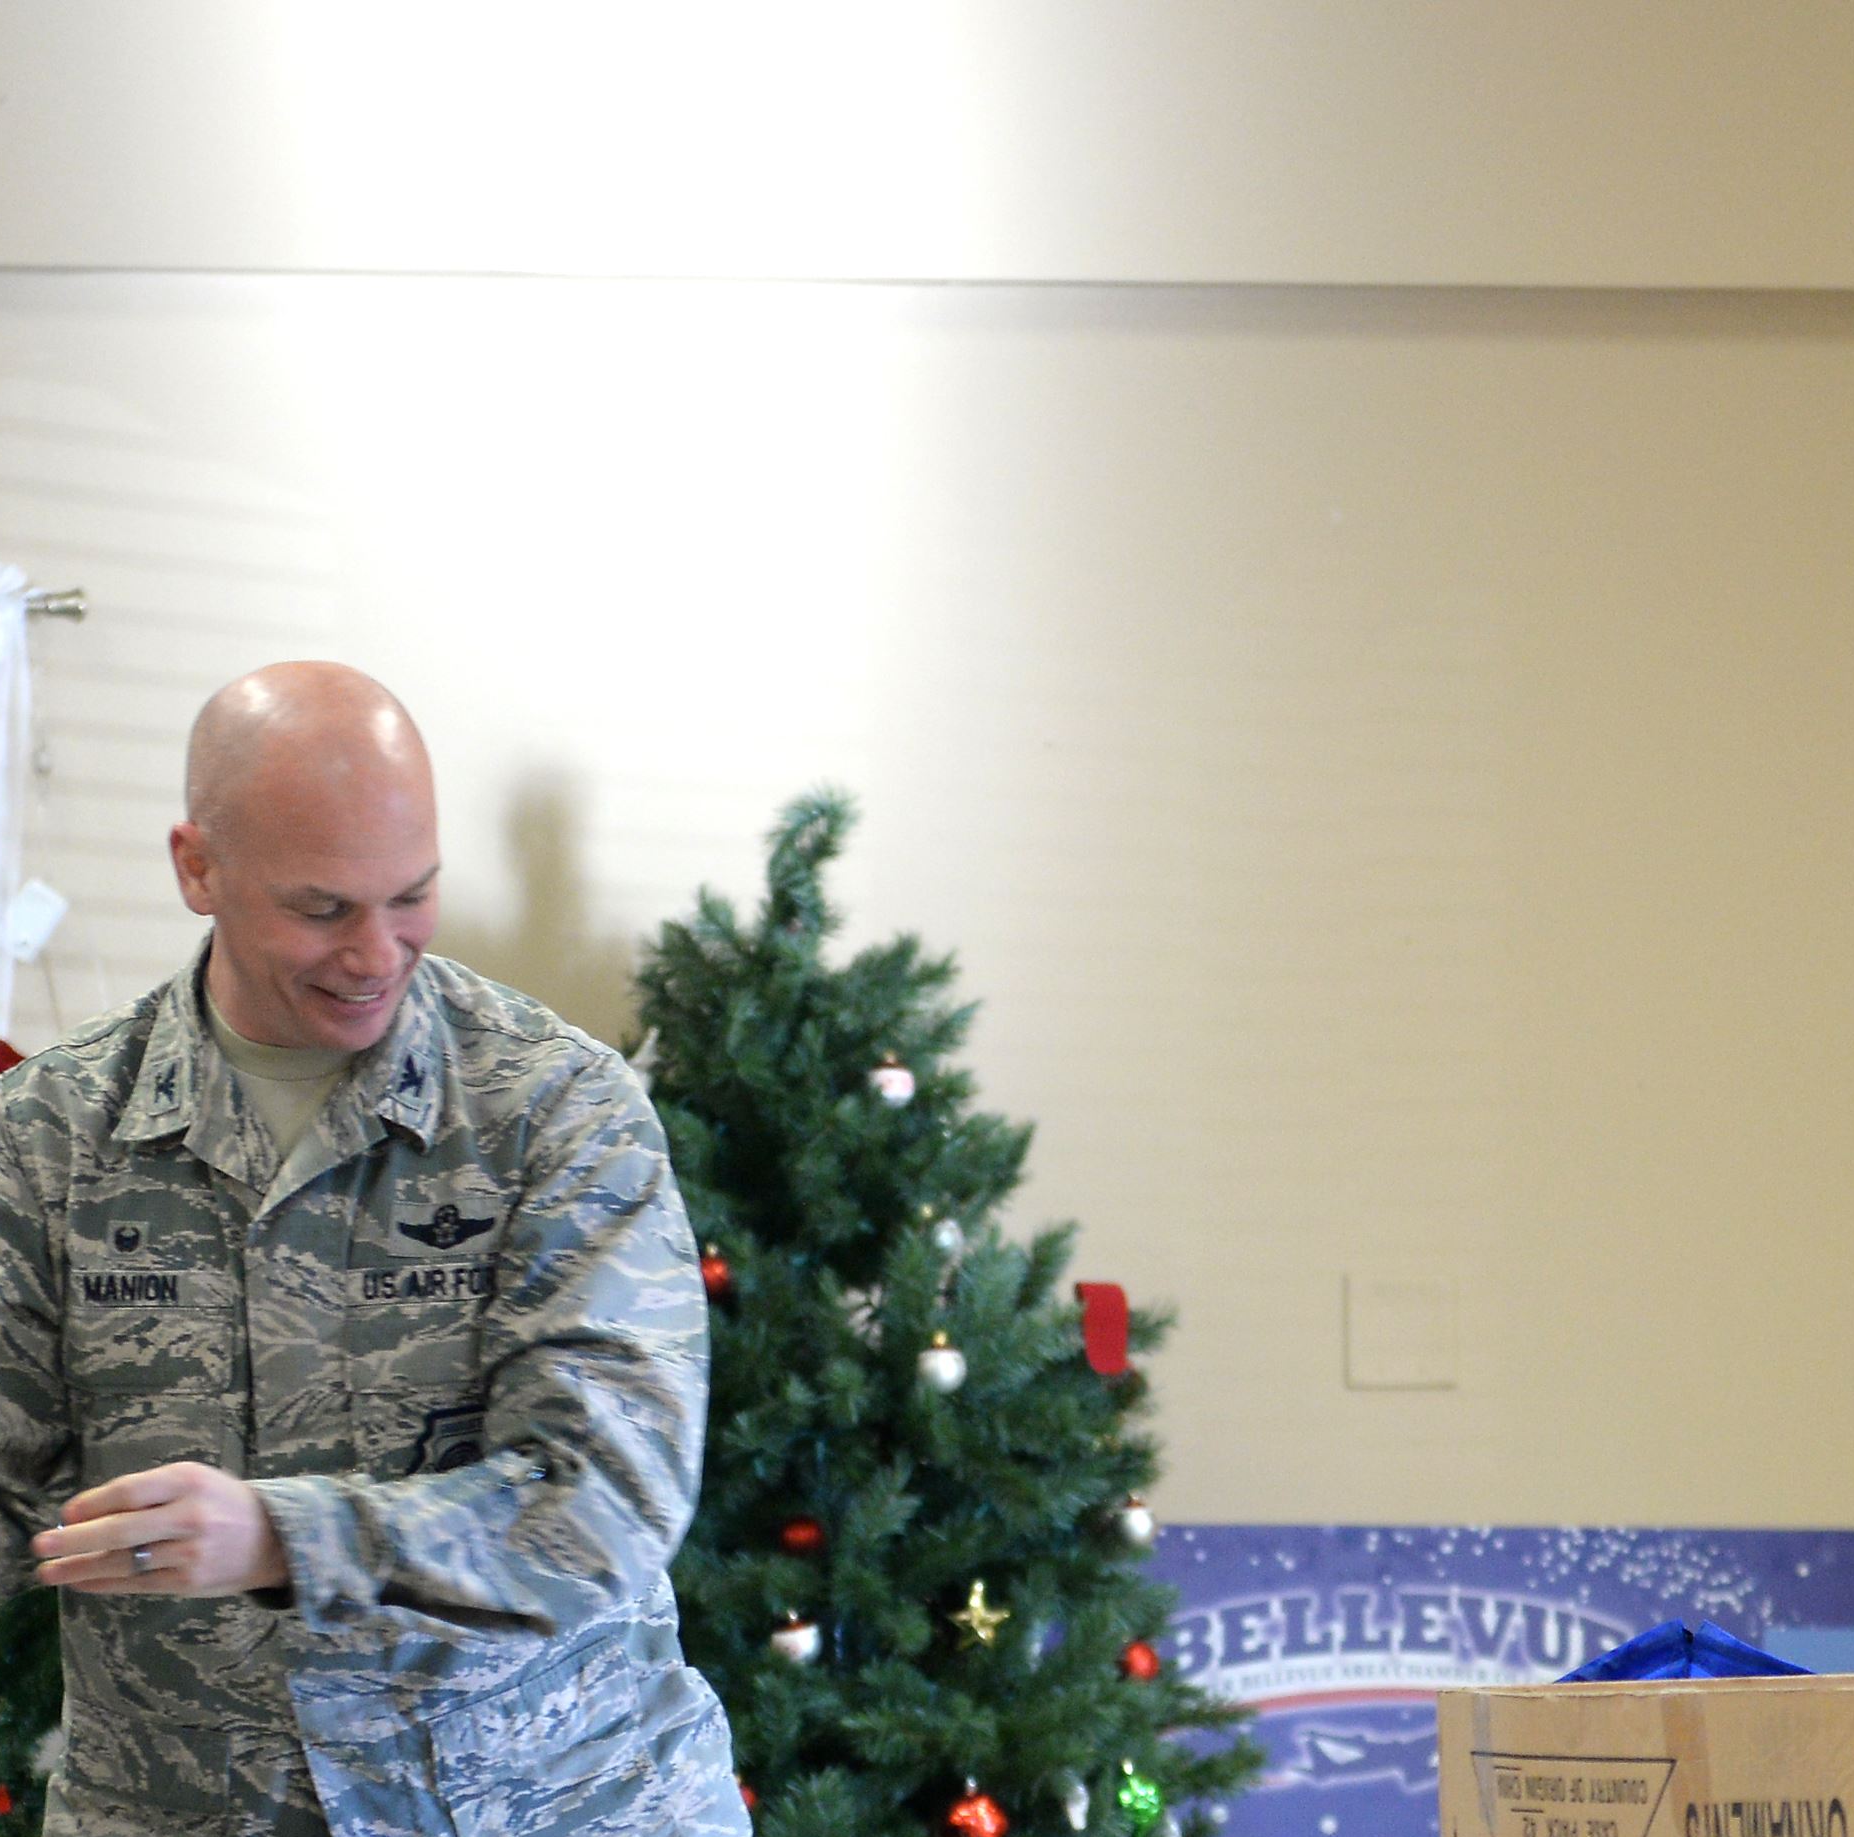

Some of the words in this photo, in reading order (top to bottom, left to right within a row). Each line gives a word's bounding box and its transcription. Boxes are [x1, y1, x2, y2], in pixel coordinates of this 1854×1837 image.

[83, 1274, 179, 1302] MANION
[401, 1269, 446, 1298] AIR
[1525, 1775, 1566, 1801] ORIGIN
[1569, 1776, 1586, 1803] OF
[1590, 1777, 1649, 1805] COUNTRY
